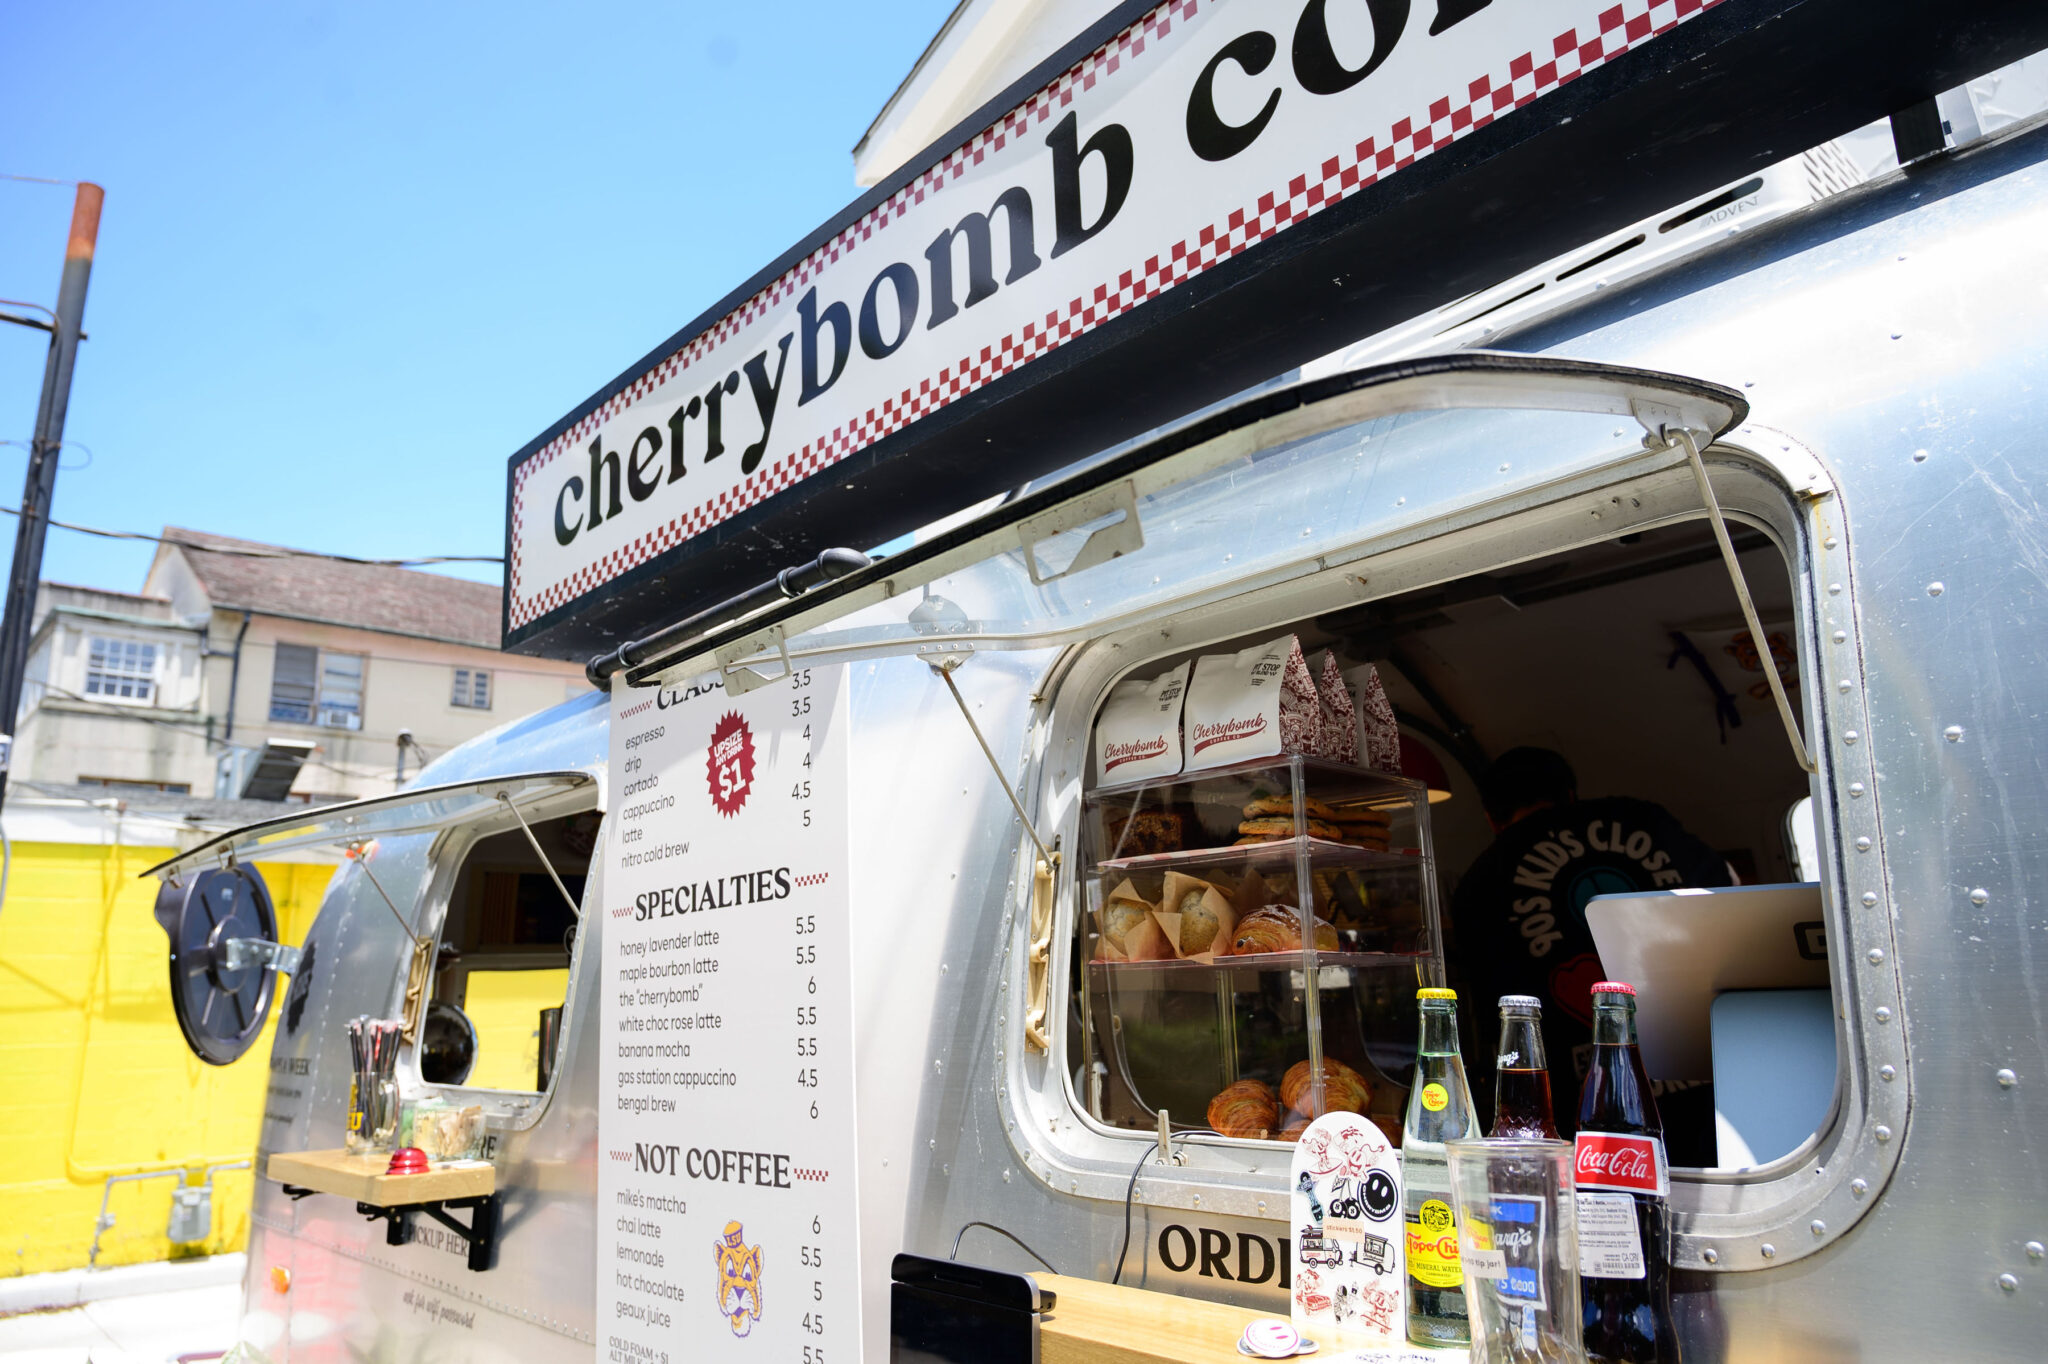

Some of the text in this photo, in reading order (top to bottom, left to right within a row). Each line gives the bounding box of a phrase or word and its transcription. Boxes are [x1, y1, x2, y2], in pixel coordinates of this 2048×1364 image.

[553, 110, 1134, 546] cherrybomb
[1262, 663, 1280, 671] STOP
[793, 669, 810, 689] 3.5
[792, 696, 810, 717] 3.5
[803, 724, 811, 740] 4
[1193, 712, 1267, 740] Cherrybomb
[626, 726, 665, 750] espresso
[714, 728, 743, 758] UPSIZE
[1104, 735, 1168, 759] Cherrybomb
[727, 741, 744, 760] DRINK
[803, 752, 811, 768] 4
[625, 758, 641, 773] drip
[624, 774, 658, 796] cortado
[719, 758, 746, 802] $1
[792, 781, 810, 799] 4.5
[623, 795, 674, 820] cappuccino
[803, 810, 810, 827] 5
[623, 829, 642, 843] latte
[622, 842, 689, 868] nitro cold brew
[1513, 829, 1585, 891] KID'S
[1586, 819, 1683, 888] CLOSE
[636, 867, 790, 921] SPECIALTIES
[796, 916, 815, 934] 5.5
[621, 931, 719, 958] honey lavender latte
[797, 946, 815, 964] 5.5
[620, 958, 718, 983] maple bourbon latte
[808, 976, 816, 994] 6
[620, 992, 634, 1006] the
[619, 1013, 721, 1031] white choc rose latte
[797, 1007, 816, 1025] 5.5
[619, 1041, 690, 1057] banana mocha
[798, 1038, 817, 1056] 5.5
[618, 1068, 736, 1089] gas station cappuccino
[798, 1069, 817, 1087] 4.5
[618, 1095, 676, 1115] bengal brew
[810, 1101, 818, 1119] 6
[635, 1143, 790, 1188] NOT COFFEE
[1577, 1144, 1649, 1179] Coca-Cola
[617, 1189, 686, 1214] mike's matcha
[617, 1216, 661, 1238] chai latte
[813, 1215, 820, 1234] 6
[1327, 1223, 1347, 1233] stickers
[445, 1232, 469, 1258] HER
[726, 1231, 742, 1247] LSU
[1406, 1232, 1438, 1254] Topo
[1437, 1236, 1461, 1260] Chi
[617, 1242, 664, 1268] lemonade
[802, 1246, 821, 1267] 5.5
[1416, 1262, 1441, 1272] MINERAL
[617, 1269, 684, 1302] hot chocolate
[814, 1281, 822, 1301] 5
[617, 1301, 670, 1328] geaux juice
[802, 1313, 823, 1335] 4.5
[609, 1335, 629, 1352] COLD
[630, 1342, 653, 1361] FOAM
[609, 1350, 623, 1364] ALT
[803, 1346, 823, 1364] 5.5
